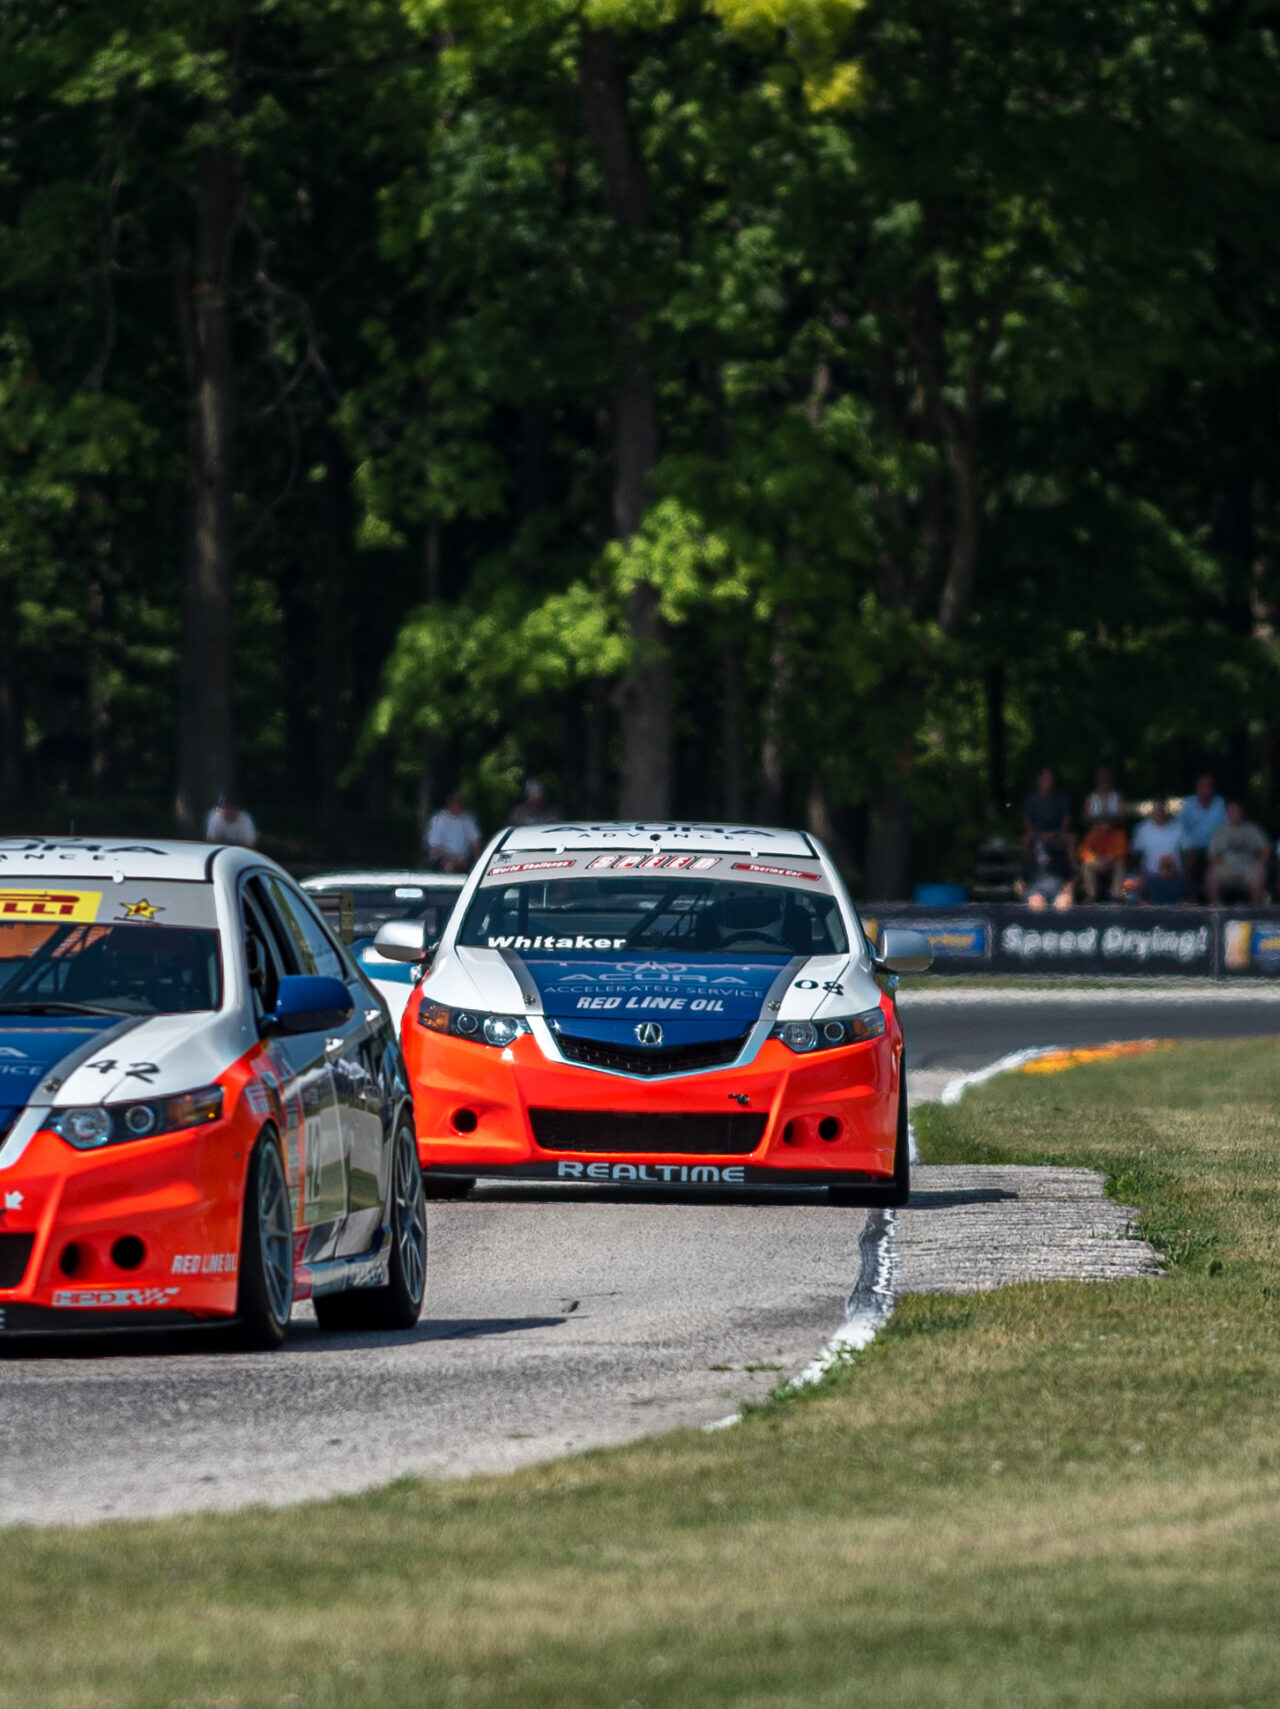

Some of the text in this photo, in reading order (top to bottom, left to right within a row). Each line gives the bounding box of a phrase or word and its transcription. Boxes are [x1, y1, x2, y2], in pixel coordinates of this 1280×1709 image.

[578, 832, 735, 841] ADVNCE
[586, 855, 721, 870] SPEED
[488, 935, 627, 950] Whitaker
[1001, 923, 1097, 958] Speed
[1101, 925, 1207, 960] Drying!
[558, 973, 749, 985] ACURA
[544, 984, 764, 999] ACCELERATED SERVICE
[794, 979, 845, 996] 08
[576, 996, 725, 1012] RED LINE OIL
[85, 1059, 161, 1083] 42
[558, 1161, 745, 1182] REALTIME
[171, 1255, 201, 1275] RED
